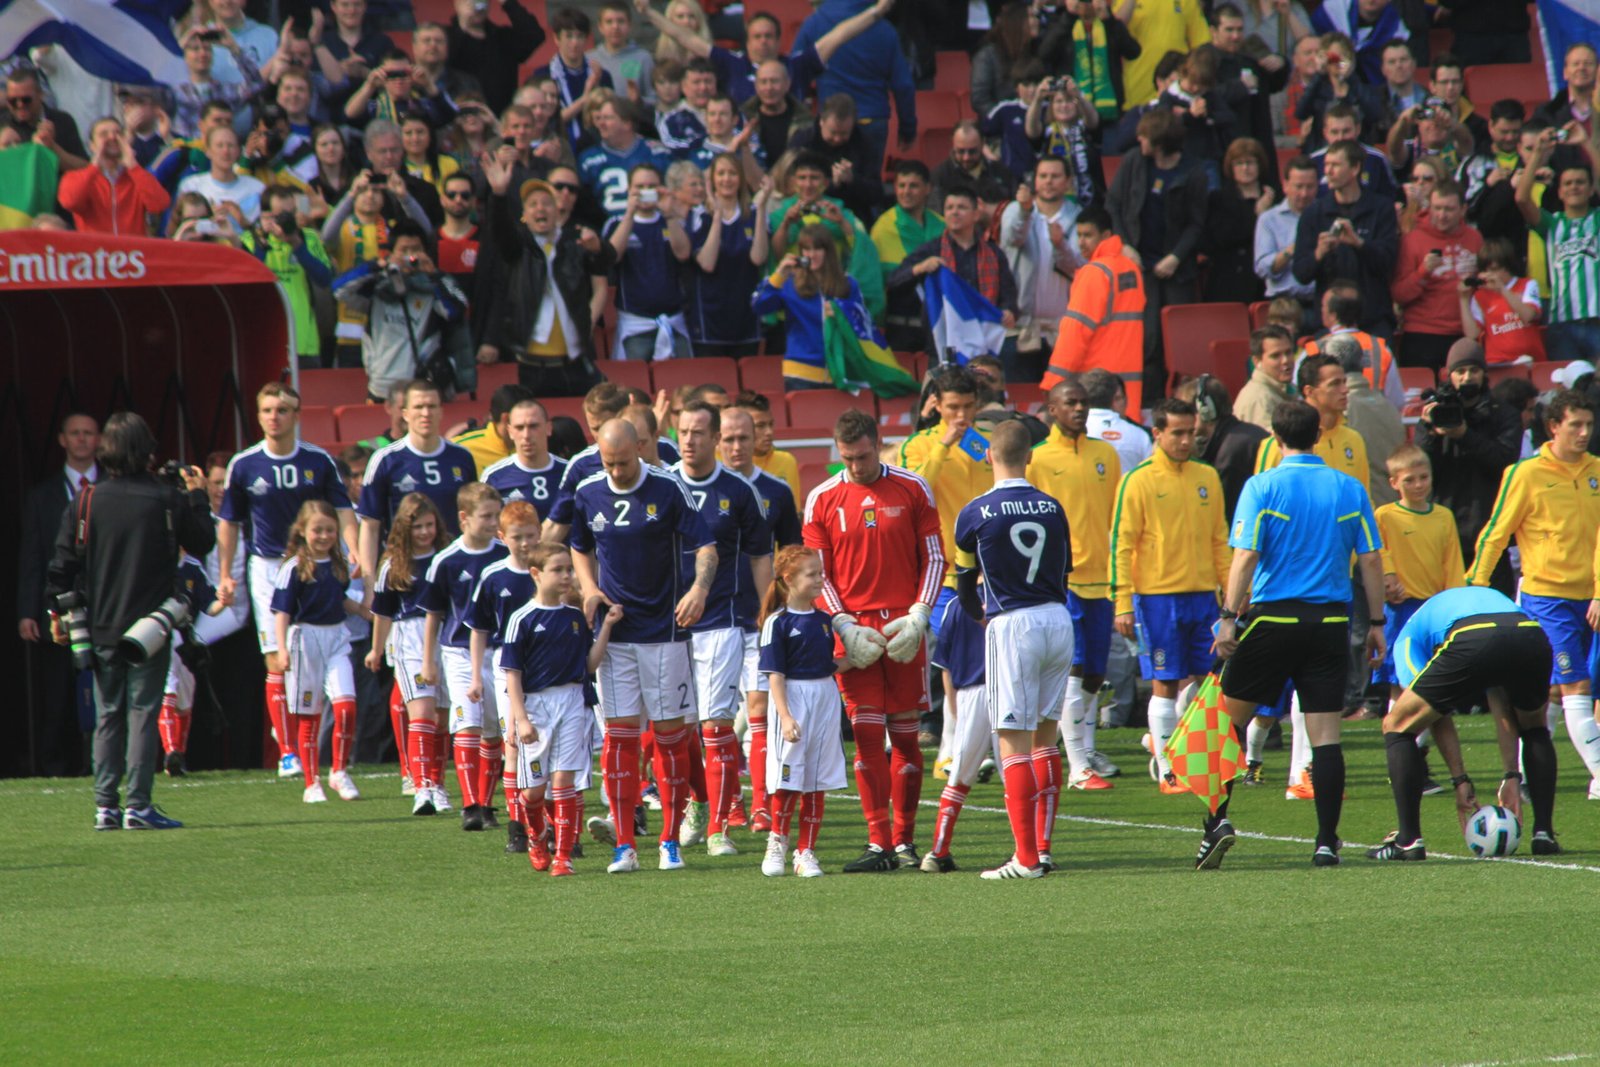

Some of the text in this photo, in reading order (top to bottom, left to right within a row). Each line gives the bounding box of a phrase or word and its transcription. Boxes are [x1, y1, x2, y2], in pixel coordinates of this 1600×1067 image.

[272, 464, 298, 489] 10
[423, 461, 442, 485] 5
[532, 476, 549, 499] 8
[692, 490, 707, 510] 7
[613, 500, 630, 526] 2
[836, 507, 846, 532] 1
[980, 500, 1057, 519] K. MILLER
[1009, 521, 1047, 584] 9
[678, 683, 690, 709] 2
[729, 685, 737, 710] 7
